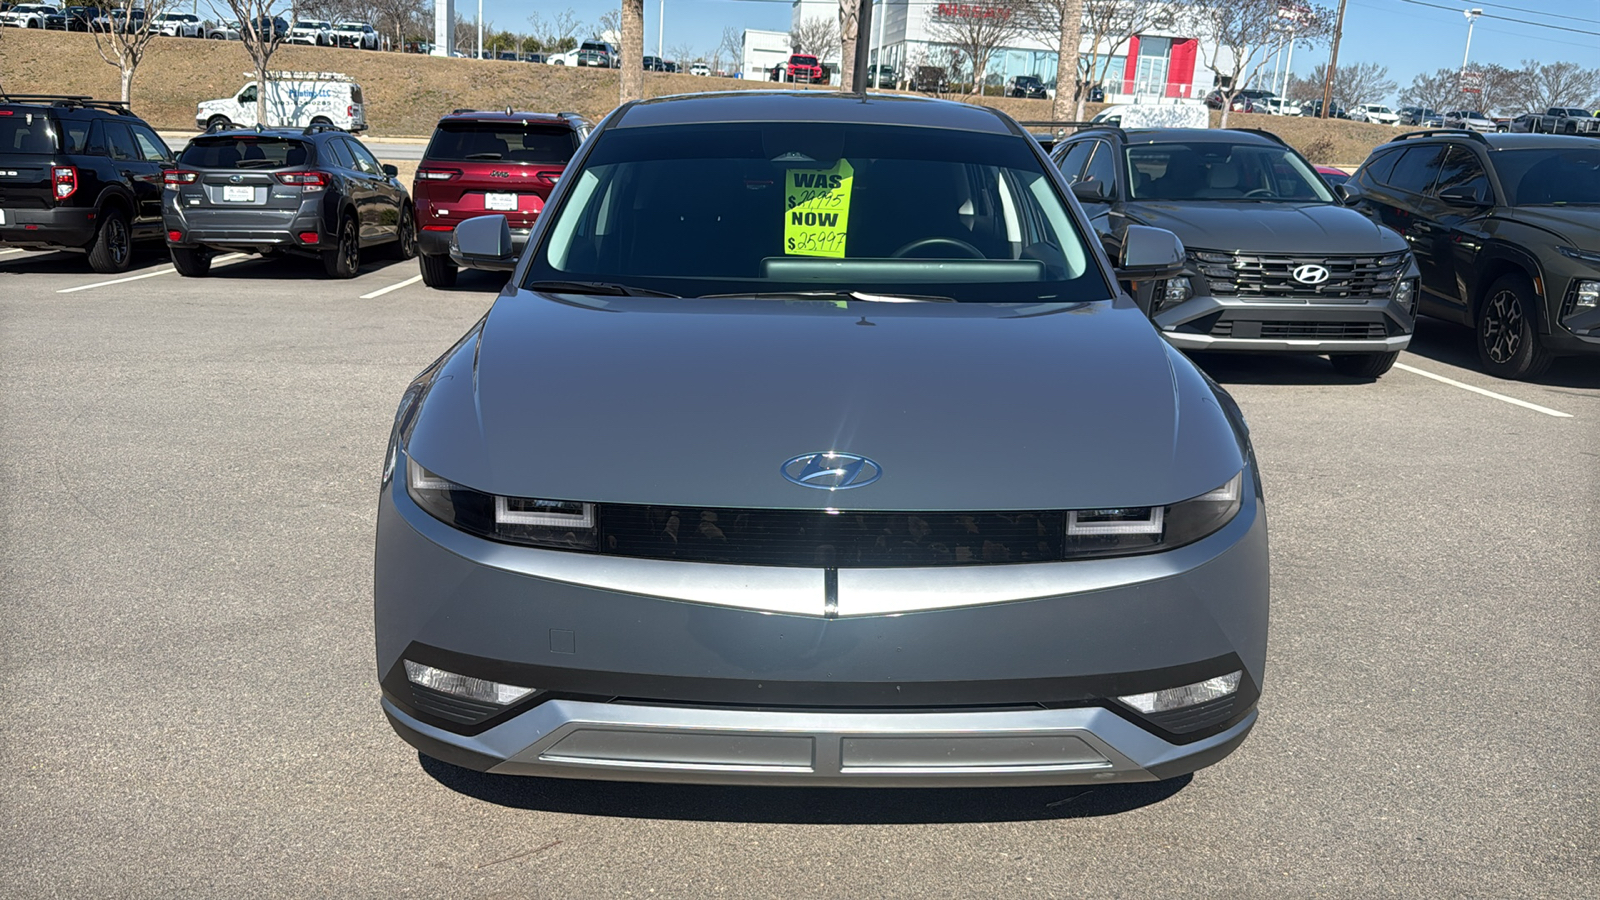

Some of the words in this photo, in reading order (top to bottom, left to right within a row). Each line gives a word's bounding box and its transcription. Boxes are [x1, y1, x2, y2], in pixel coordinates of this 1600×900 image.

[938, 3, 1010, 20] NISSAN
[319, 89, 331, 97] LLC
[490, 169, 509, 178] Jeep
[794, 173, 842, 188] WAS
[791, 211, 839, 227] NOW
